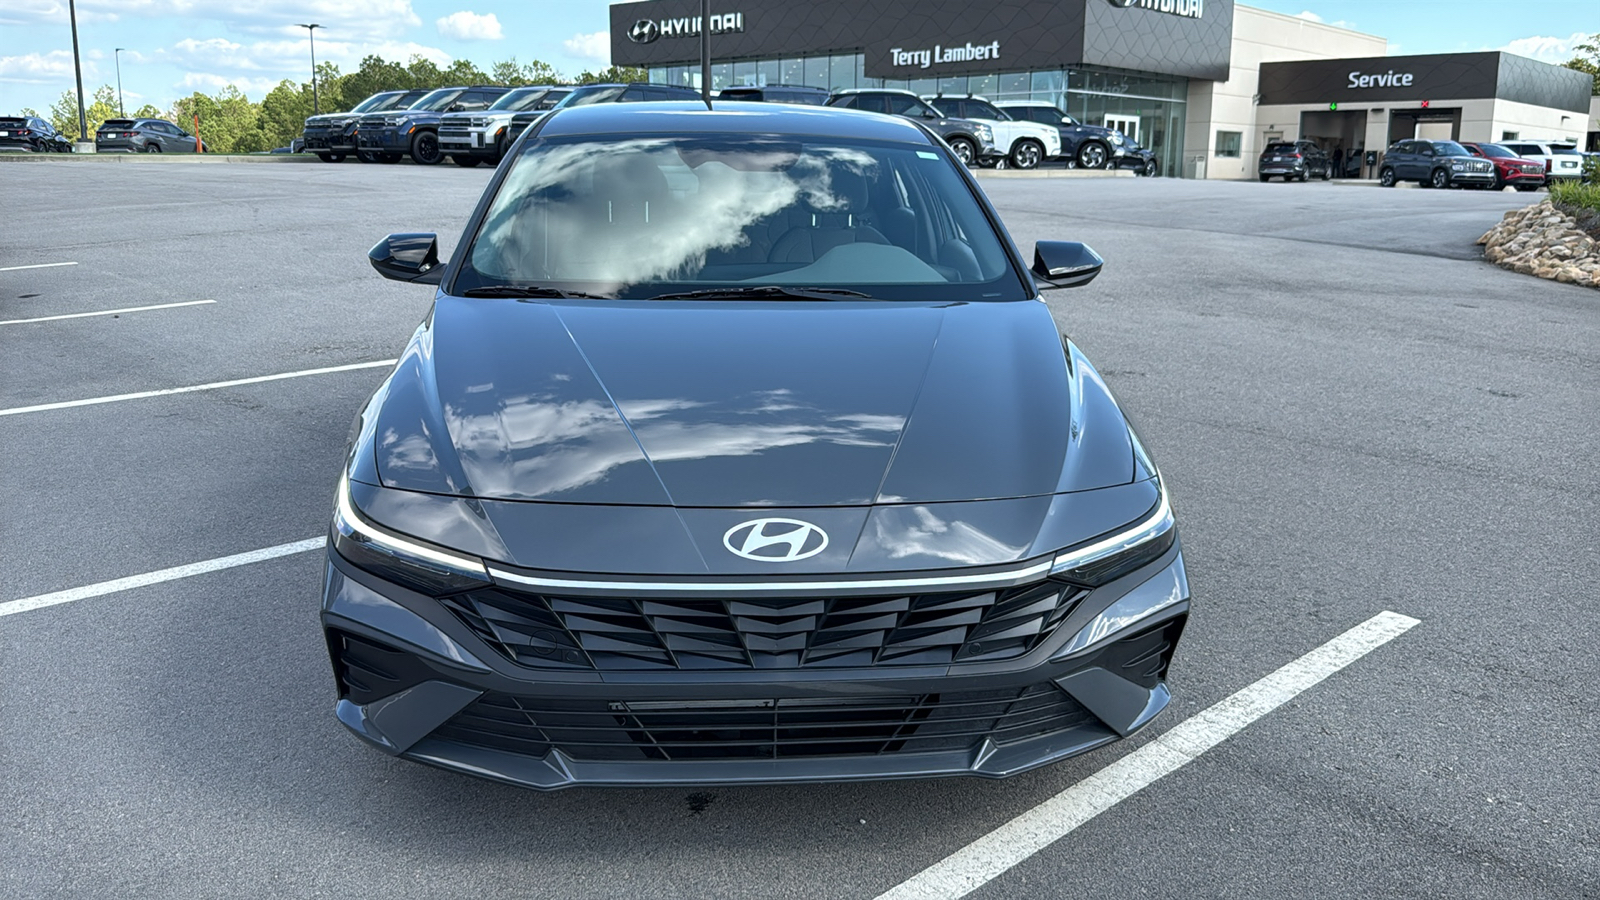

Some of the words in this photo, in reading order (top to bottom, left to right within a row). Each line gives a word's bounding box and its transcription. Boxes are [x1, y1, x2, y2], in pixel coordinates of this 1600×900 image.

[890, 48, 931, 69] Terry
[934, 40, 1000, 63] Lambert
[1347, 70, 1413, 88] Service
